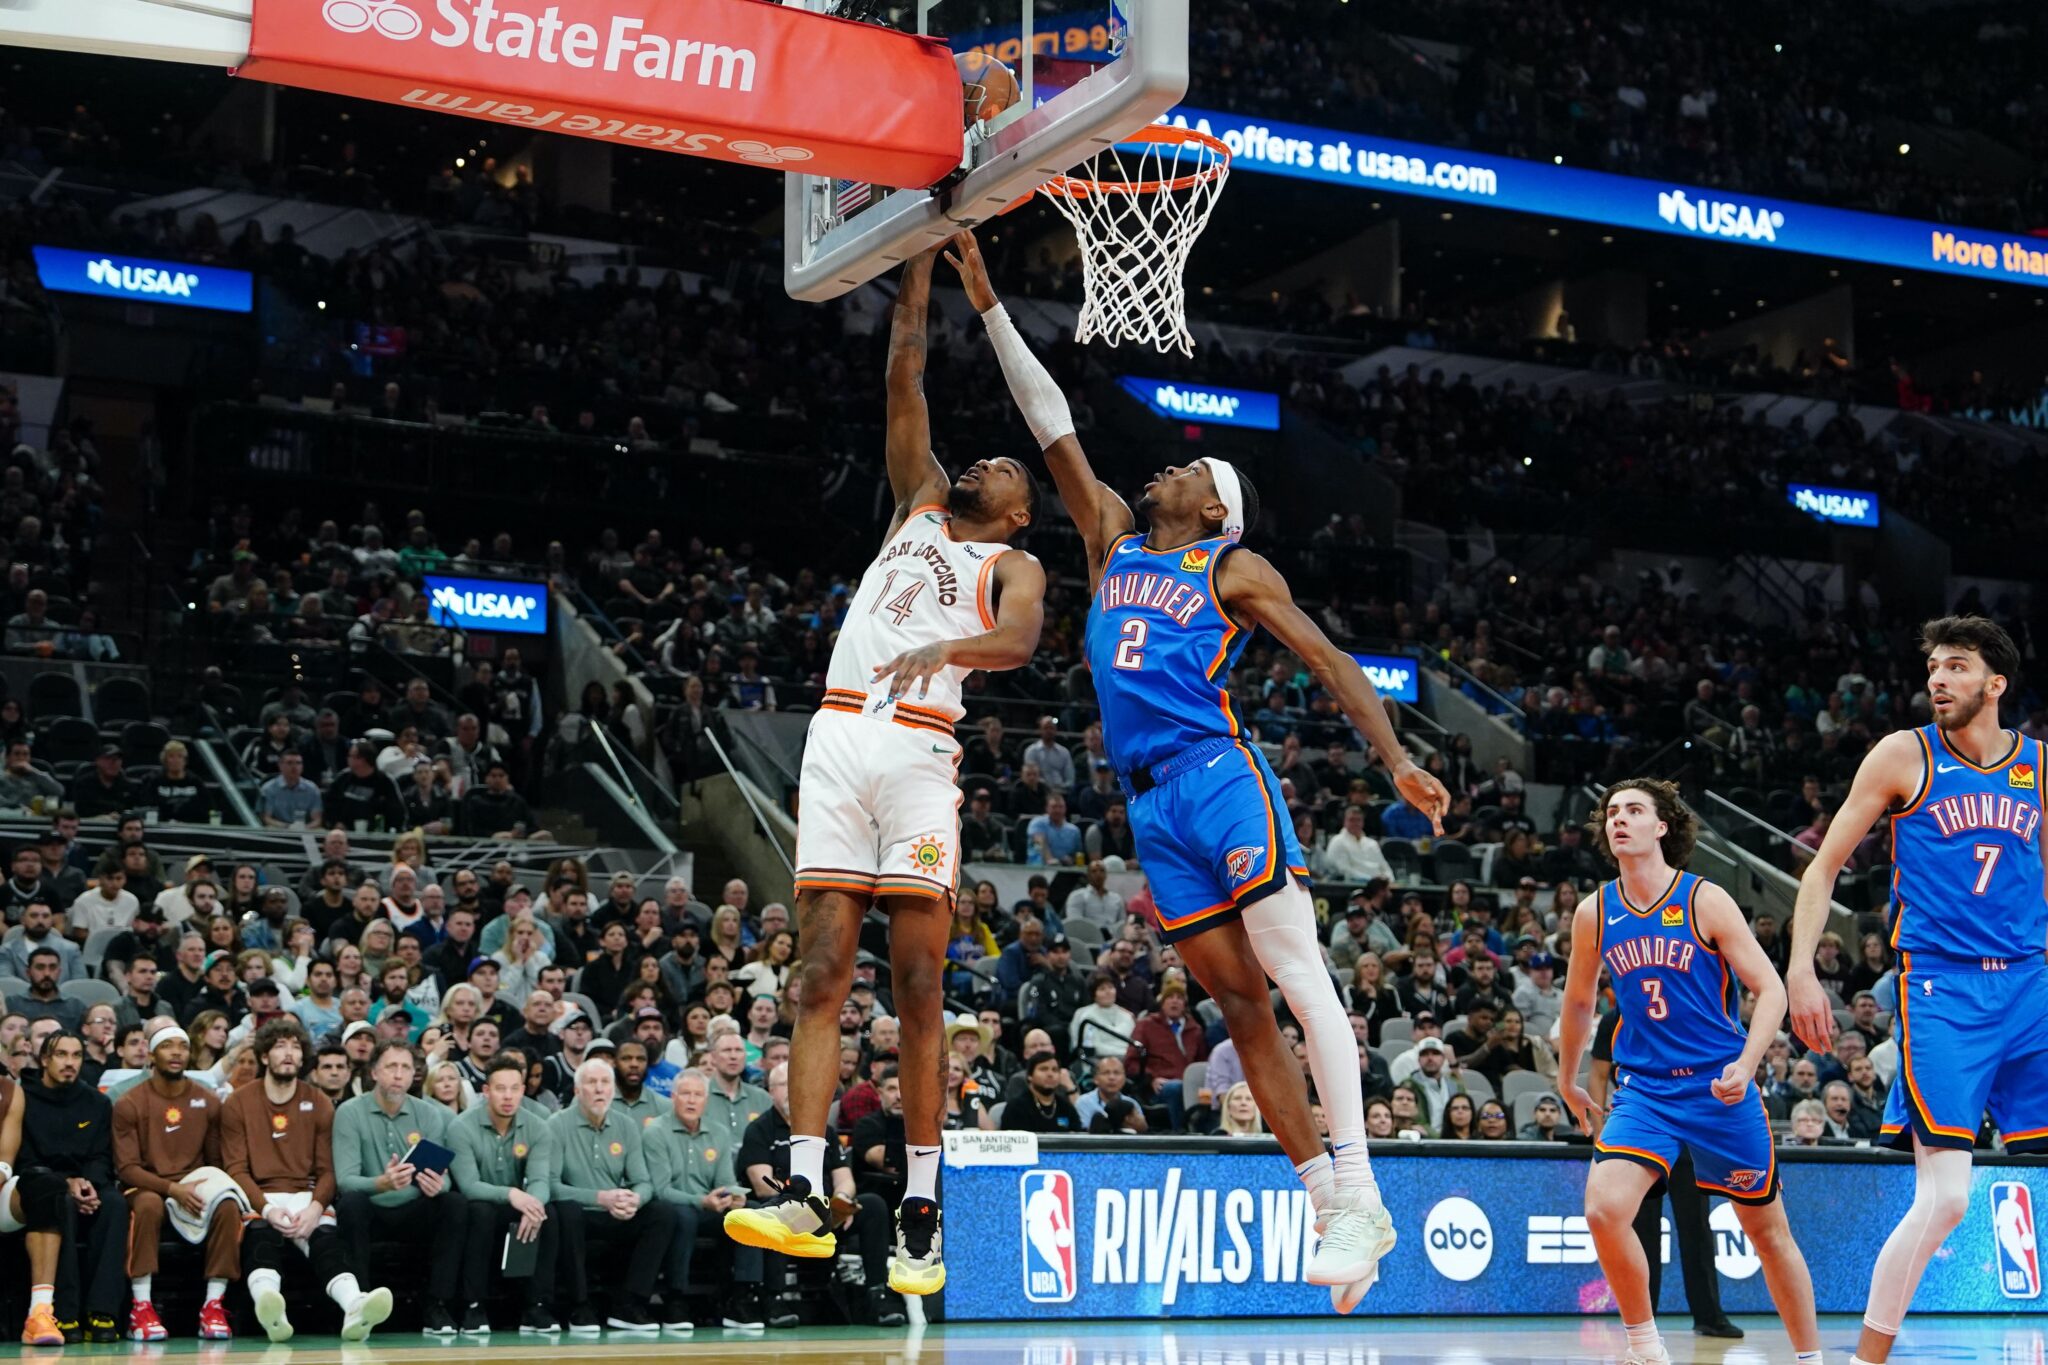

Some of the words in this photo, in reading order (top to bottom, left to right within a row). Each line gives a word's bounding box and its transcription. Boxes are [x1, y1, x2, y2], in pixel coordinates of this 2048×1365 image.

[1222, 125, 1313, 168] offers
[1319, 141, 1351, 174] at
[1357, 149, 1497, 195] usaa.com
[1932, 231, 1998, 269] More
[913, 542, 958, 607] ANTONIO
[1182, 561, 1206, 571] Love's
[869, 568, 927, 626] 14
[1100, 573, 1206, 628] THUNDER
[1113, 618, 1148, 670] 2
[1362, 665, 1405, 691] SAA
[2010, 778, 2034, 788] Love's
[1928, 793, 2040, 843] THUNDER
[1972, 844, 2002, 895] 7
[1605, 936, 1695, 977] THUNDER
[1641, 978, 1669, 1021] 3
[963, 1136, 982, 1144] SAN
[985, 1136, 1028, 1144] ANTONIO
[979, 1144, 1012, 1153] SPURS
[1093, 1168, 1254, 1305] RIVALS
[1430, 1222, 1488, 1250] abc
[1032, 1271, 1057, 1293] NBA
